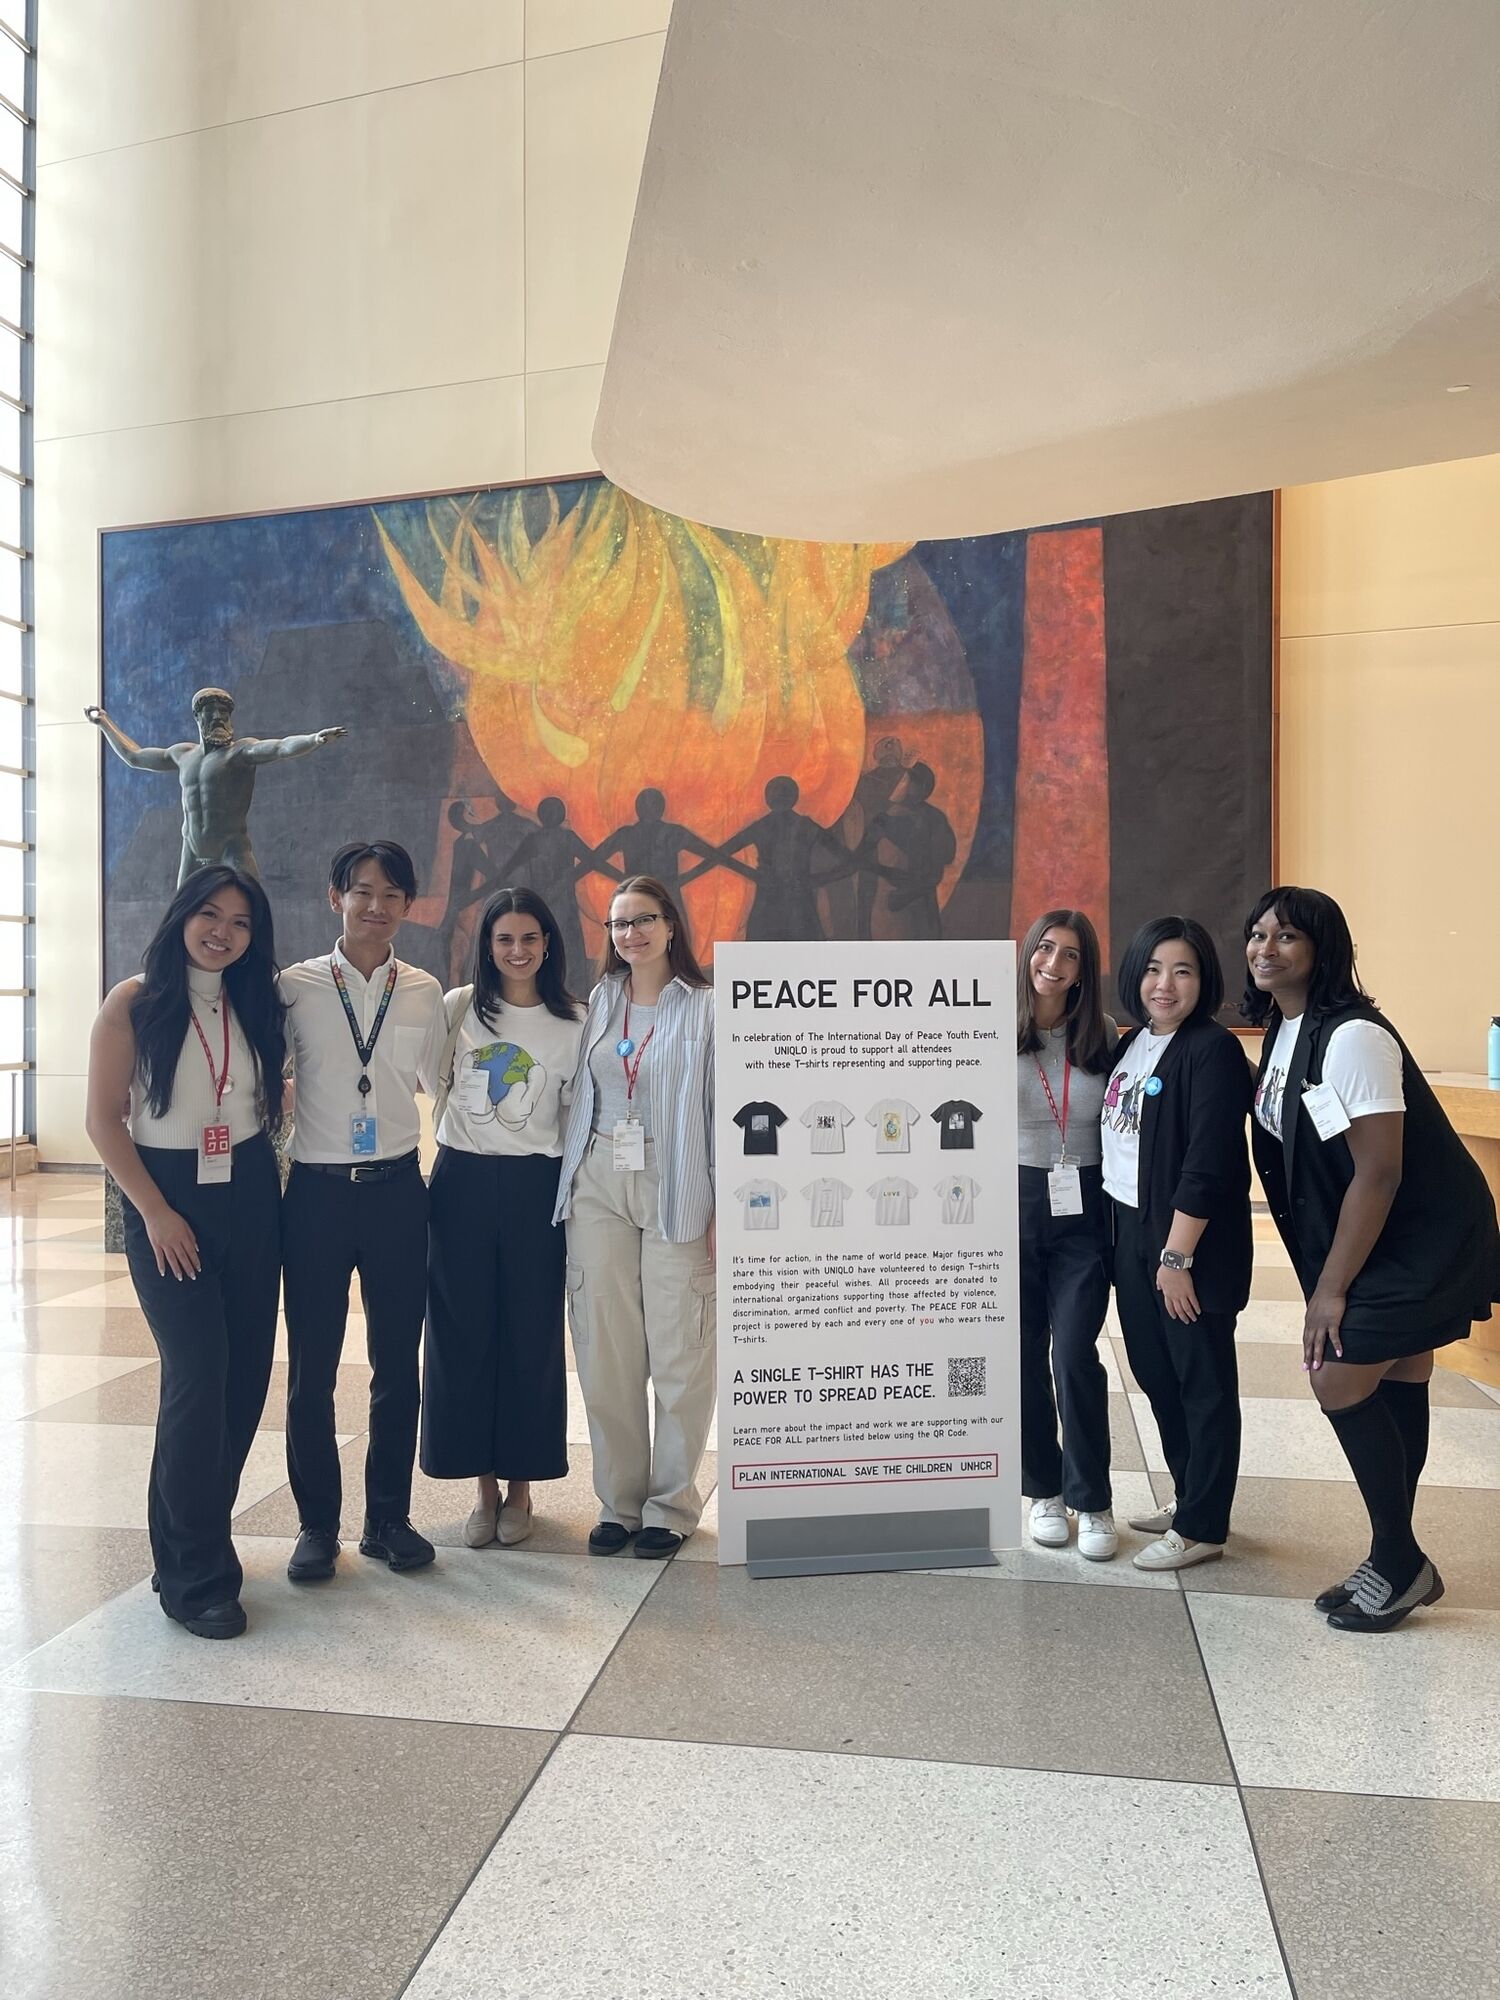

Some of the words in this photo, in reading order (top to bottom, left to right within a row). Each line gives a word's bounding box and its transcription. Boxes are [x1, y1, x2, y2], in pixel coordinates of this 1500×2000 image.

[732, 979, 838, 1009] PEACE
[853, 979, 913, 1008] FOR
[928, 979, 992, 1007] ALL
[732, 1033, 741, 1042] In
[743, 1033, 792, 1042] celebration
[795, 1032, 804, 1042] of
[808, 1032, 824, 1041] The
[827, 1031, 882, 1041] International
[885, 1031, 901, 1042] Day
[904, 1031, 914, 1040] of
[917, 1031, 943, 1040] Peace
[946, 1030, 970, 1040] Youth
[973, 1030, 999, 1040] Event,
[774, 1046, 808, 1057] UNIQLO
[811, 1046, 818, 1055] is
[821, 1045, 846, 1057] proud
[849, 1045, 859, 1054] to
[861, 1045, 894, 1056] support
[897, 1045, 908, 1054] all
[911, 1044, 952, 1053] attendees
[745, 1060, 765, 1069] with
[768, 1060, 791, 1069] these
[794, 1059, 829, 1069] T-shirts
[832, 1058, 886, 1070] representing
[889, 1058, 905, 1067] and
[908, 1057, 952, 1069] supporting
[956, 1059, 982, 1069] peace.
[732, 1256, 744, 1264] It's
[748, 1256, 766, 1264] time
[769, 1255, 782, 1263] for
[785, 1254, 812, 1263] action,
[826, 1253, 839, 1261] the
[867, 1252, 875, 1260] of
[878, 1252, 902, 1260] world
[904, 1253, 929, 1261] peace.
[932, 1250, 954, 1260] Major
[957, 1250, 984, 1260] figures
[987, 1249, 1004, 1257] who
[732, 1269, 755, 1278] share
[758, 1268, 773, 1277] this
[776, 1268, 799, 1276] vision
[802, 1267, 820, 1275] with
[824, 1266, 854, 1275] UNIQLO
[858, 1266, 876, 1274] have
[880, 1264, 926, 1273] volunteered
[929, 1264, 938, 1272] to
[940, 1263, 965, 1273] design
[968, 1262, 1000, 1271] T-shirts
[732, 1282, 775, 1292] embodying
[781, 1281, 800, 1289] their
[805, 1280, 839, 1290] peaceful
[844, 1279, 872, 1287] wishes.
[878, 1278, 890, 1287] All
[895, 1277, 930, 1288] proceeds
[953, 1276, 984, 1284] donated
[990, 1275, 998, 1283] to
[732, 1294, 784, 1304] international
[787, 1294, 839, 1304] organizations
[843, 1292, 885, 1302] supporting
[888, 1291, 910, 1299] those
[913, 1290, 946, 1299] affected
[950, 1289, 960, 1299] by
[963, 1289, 997, 1297] violence,
[732, 1308, 790, 1318] discrimination,
[794, 1307, 820, 1315] armed
[824, 1306, 854, 1315] conflict
[857, 1305, 872, 1314] and
[875, 1304, 907, 1315] poverty.
[911, 1303, 926, 1312] The
[929, 1302, 957, 1311] PEACE
[960, 1301, 978, 1310] FOR
[980, 1301, 998, 1310] ALL
[732, 1322, 761, 1332] project
[764, 1321, 771, 1330] is
[774, 1320, 808, 1331] powered
[811, 1320, 821, 1330] by
[824, 1319, 844, 1328] each
[847, 1319, 861, 1327] and
[864, 1320, 887, 1328] every
[907, 1317, 916, 1325] of
[920, 1318, 935, 1326] you
[938, 1316, 955, 1324] who
[984, 1314, 1006, 1323] these
[733, 1370, 744, 1384] A
[750, 1367, 802, 1383] SINGLE
[807, 1365, 864, 1381] T-SHIRT
[871, 1364, 900, 1379] HAS
[906, 1363, 934, 1377] THE
[734, 1390, 788, 1406] POWER
[794, 1389, 813, 1403] TO
[819, 1387, 877, 1403] SPREAD
[884, 1384, 936, 1400] PEACE.
[733, 1426, 758, 1435] Learn
[784, 1424, 806, 1433] about
[826, 1422, 852, 1432] impact
[856, 1421, 870, 1430] and
[872, 1420, 893, 1429] work
[927, 1417, 968, 1428] supporting
[970, 1416, 988, 1425] with
[733, 1437, 762, 1446] PEACE
[765, 1436, 782, 1445] FOR
[785, 1436, 803, 1444] ALL
[806, 1435, 840, 1445] partners
[843, 1433, 865, 1442] listed
[868, 1432, 891, 1441] below
[894, 1432, 914, 1441] using
[933, 1429, 945, 1439] QR
[948, 1429, 968, 1437] Code.
[739, 1471, 766, 1482] PLAN
[770, 1467, 847, 1480] INTERNATIONAL
[854, 1466, 879, 1477] SAVE
[882, 1465, 902, 1475] THE
[906, 1462, 953, 1474] CHILDREN
[960, 1461, 992, 1472] UNHCR
